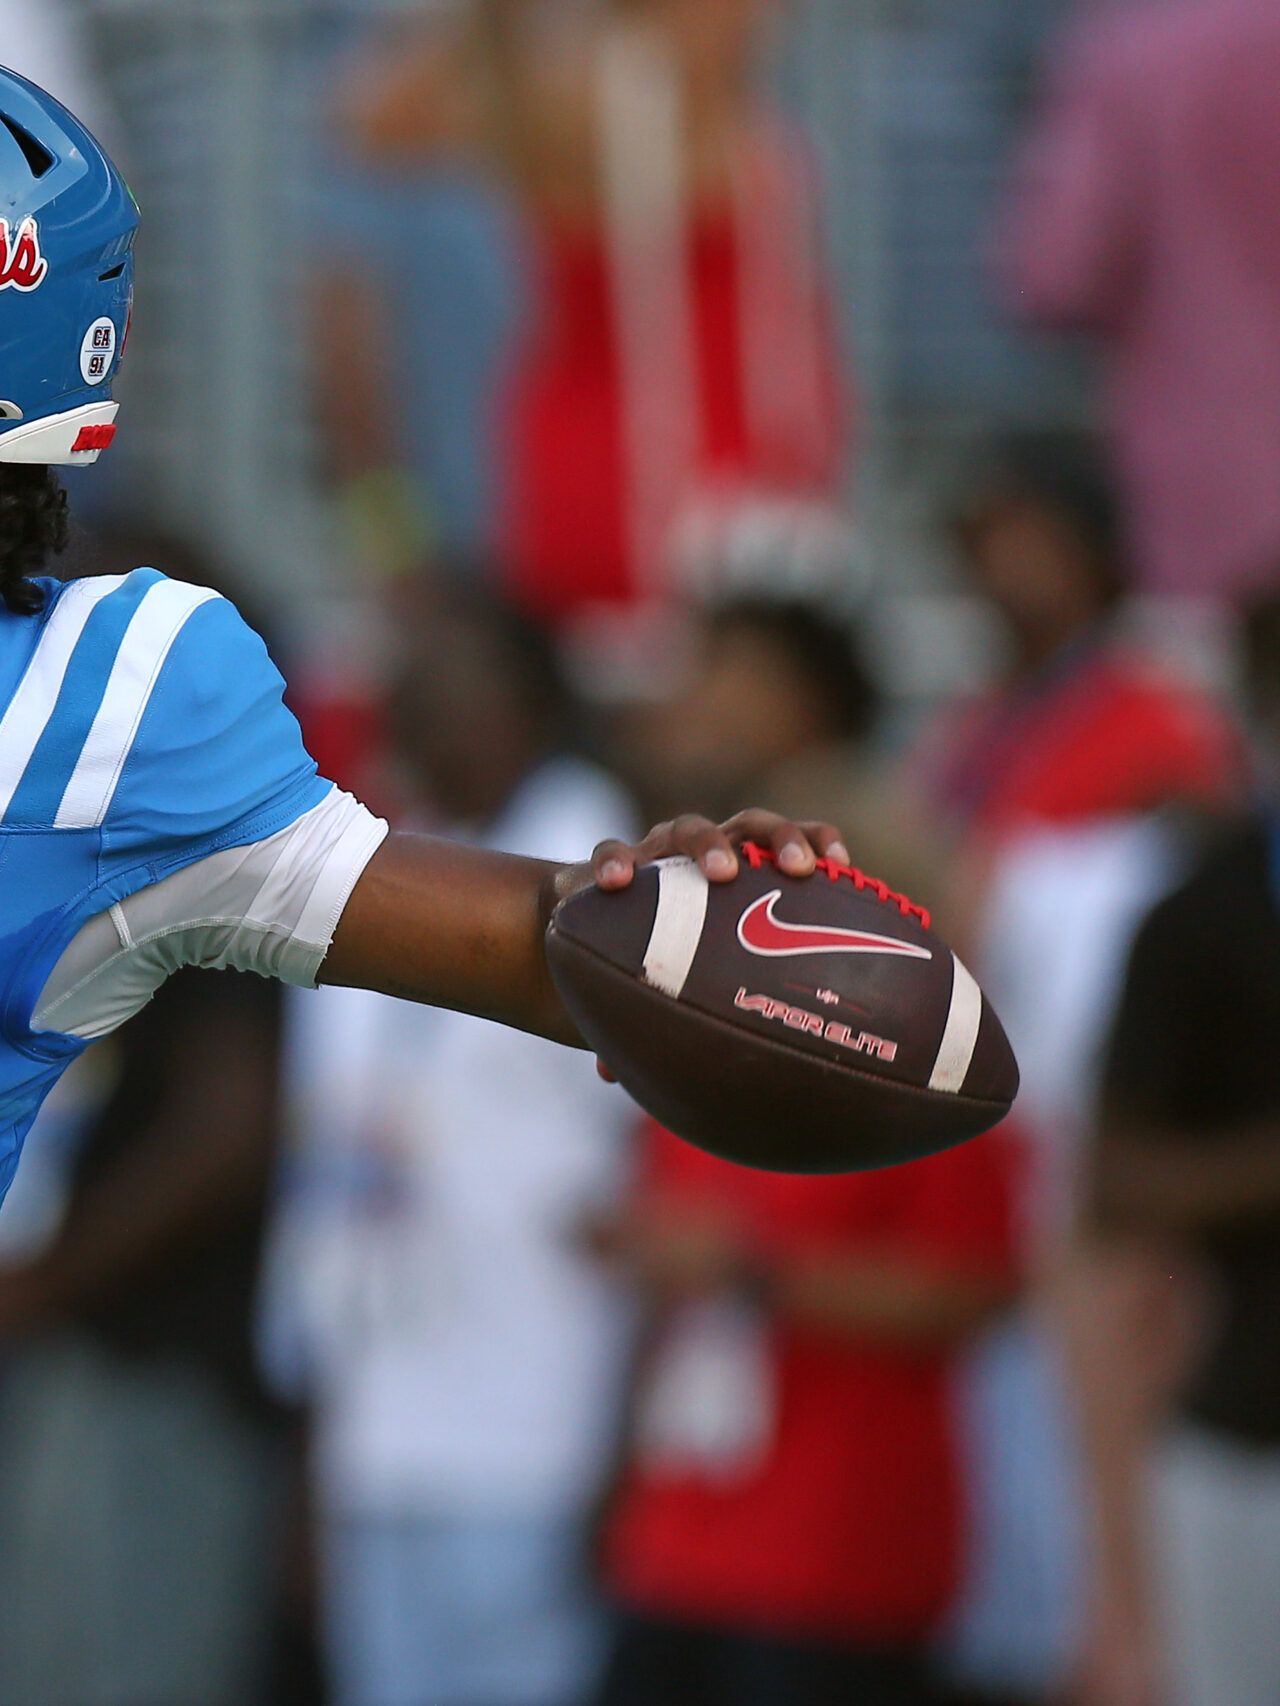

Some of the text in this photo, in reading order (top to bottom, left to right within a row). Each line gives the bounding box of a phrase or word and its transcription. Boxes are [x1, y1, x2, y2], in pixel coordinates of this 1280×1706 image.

[92, 326, 111, 349] CA
[88, 354, 105, 377] 91
[734, 985, 898, 1062] VAPOR ELITE
